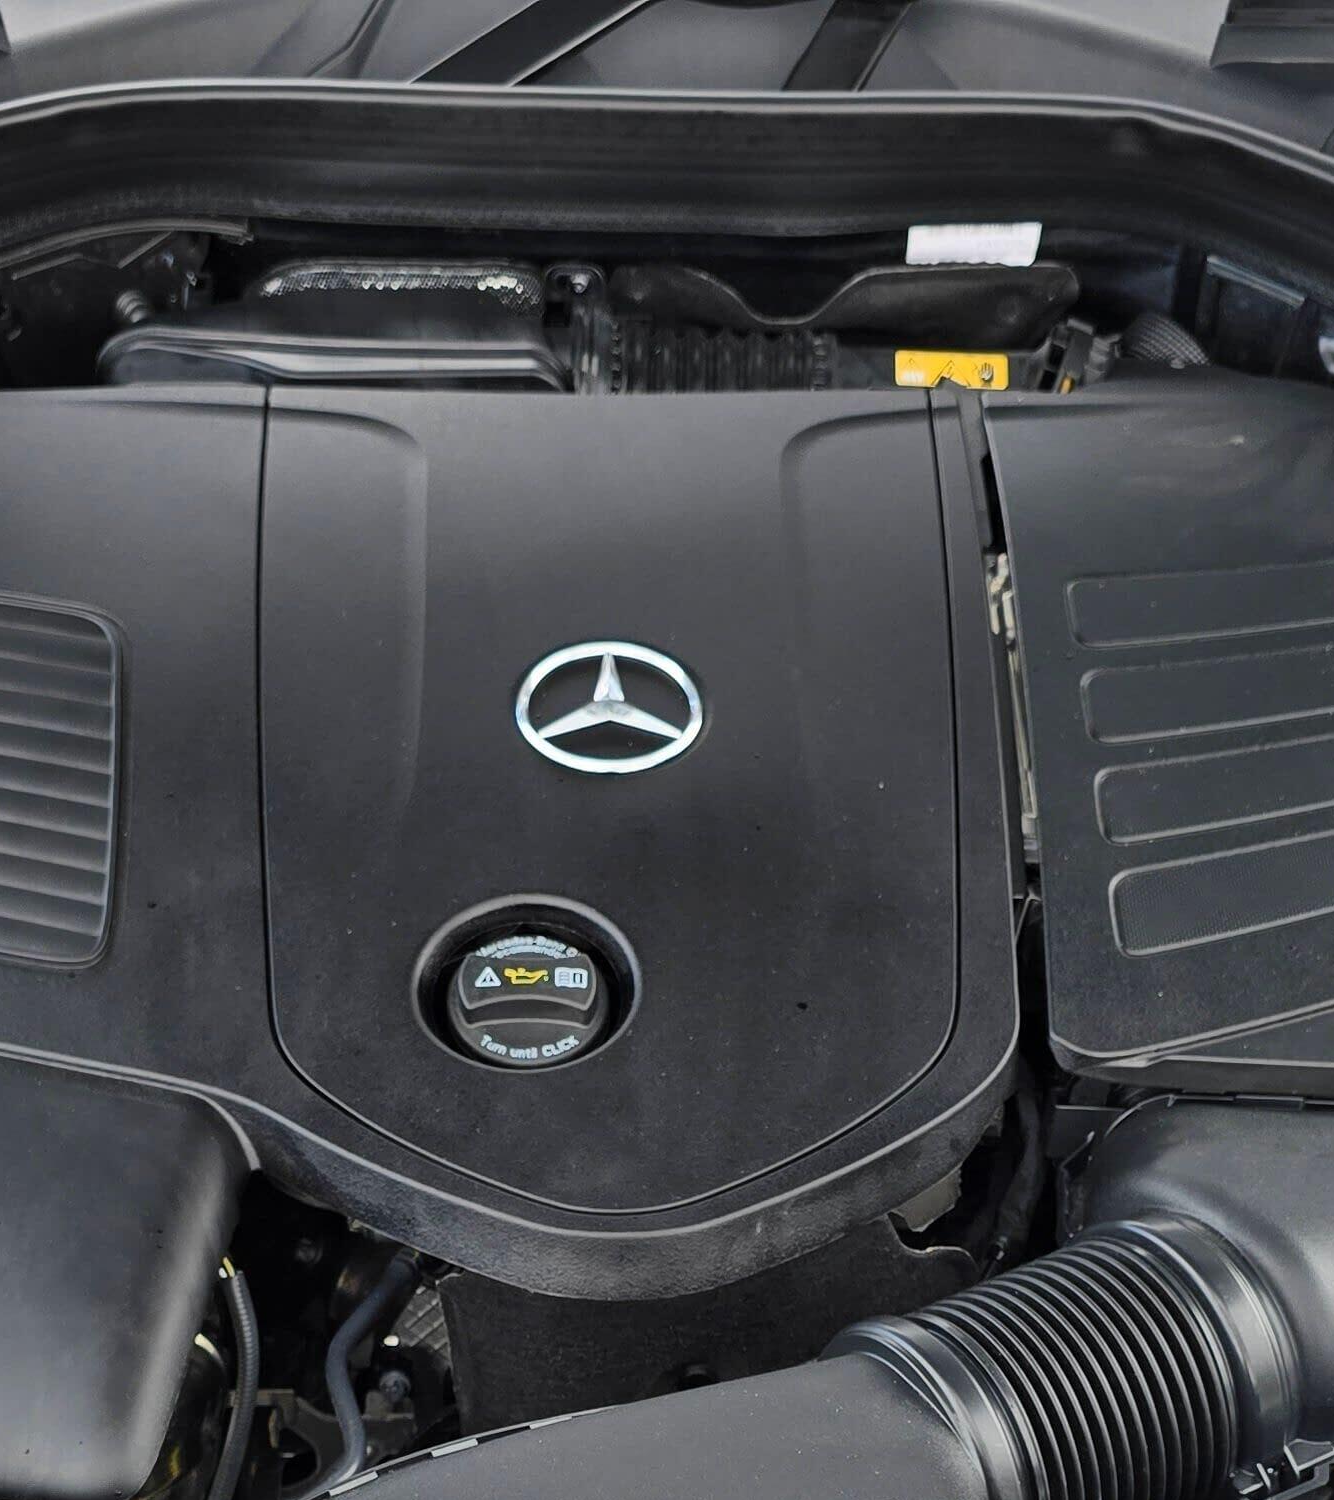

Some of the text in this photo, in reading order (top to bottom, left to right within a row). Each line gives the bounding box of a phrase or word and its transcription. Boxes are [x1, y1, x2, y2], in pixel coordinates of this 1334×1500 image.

[480, 1033, 580, 1059] Turn until CLICK
